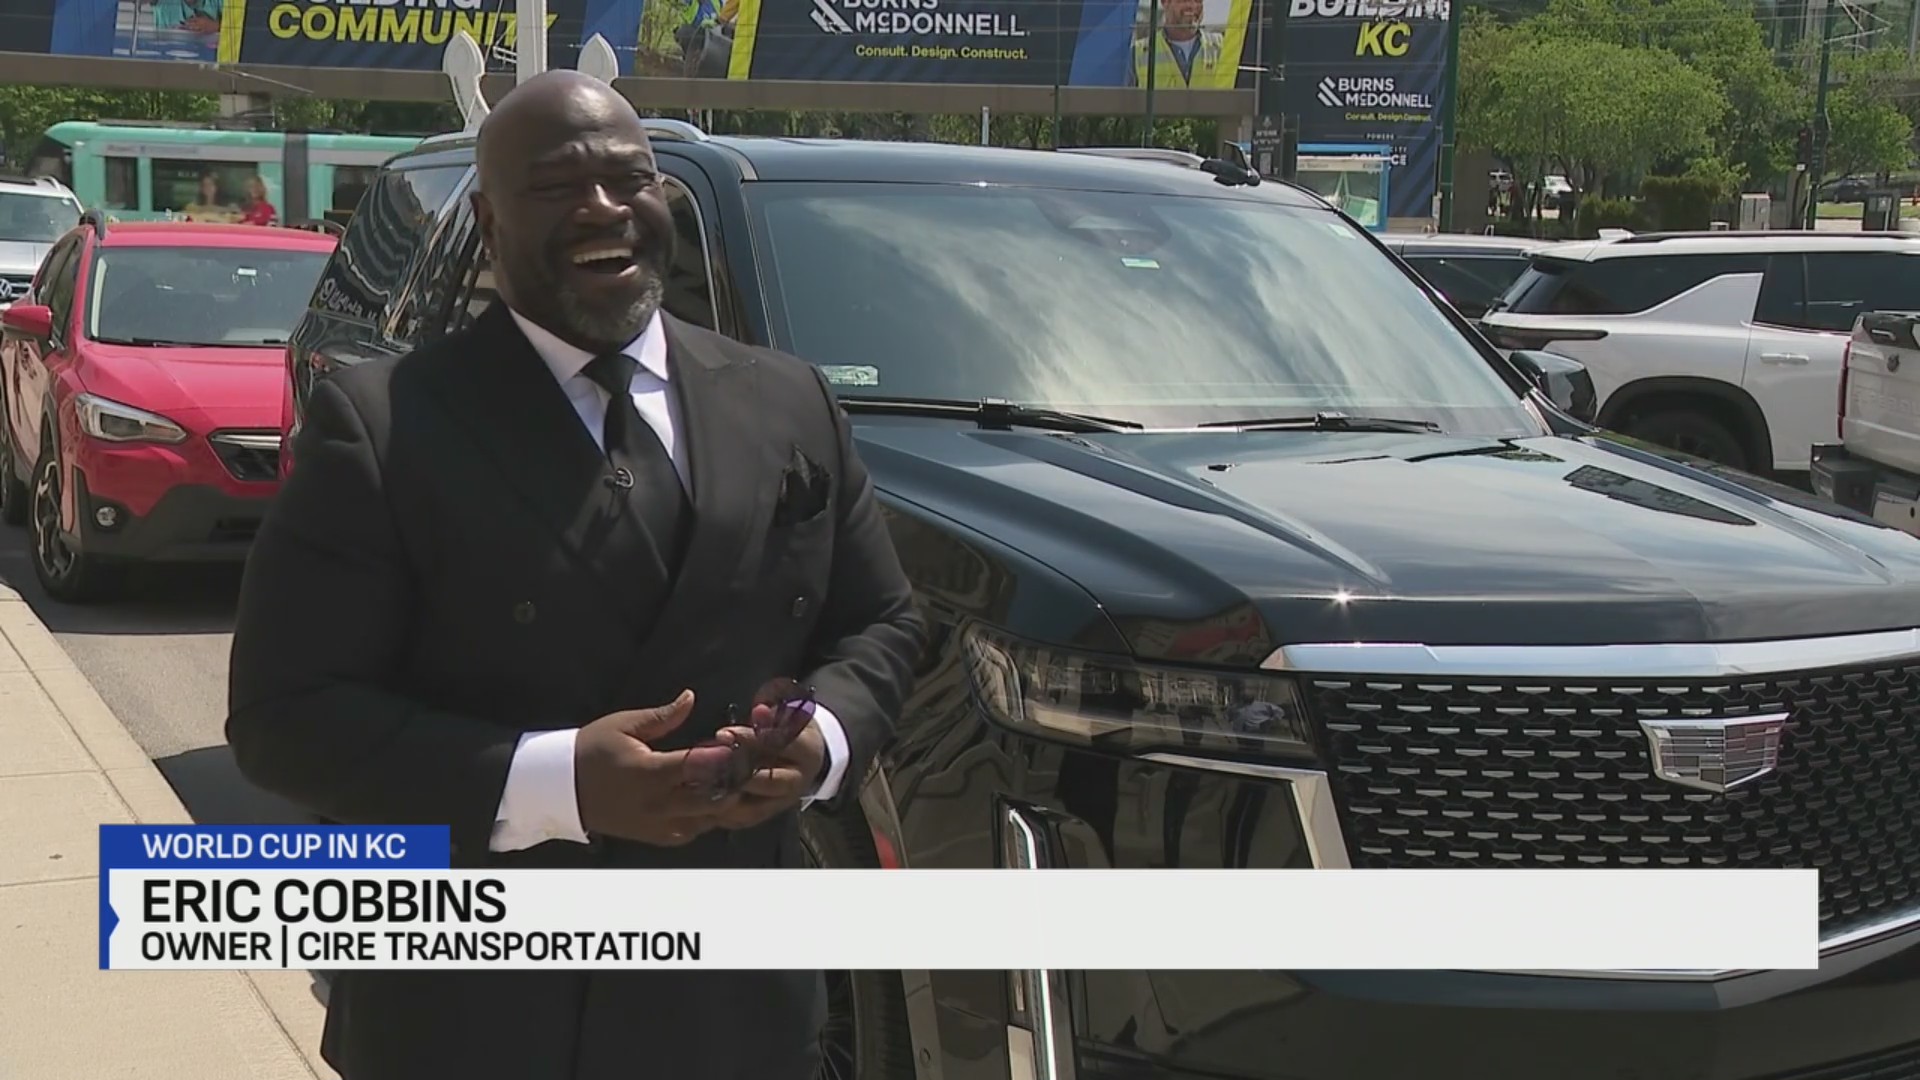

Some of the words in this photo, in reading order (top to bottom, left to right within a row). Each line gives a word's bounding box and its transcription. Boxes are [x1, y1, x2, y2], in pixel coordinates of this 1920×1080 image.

[269, 5, 558, 46] COMMUNIT
[1356, 22, 1411, 56] KC
[856, 45, 908, 57] Consult.
[911, 46, 958, 59] Design.
[961, 47, 1028, 59] Construct.
[1338, 78, 1395, 91] BURNS
